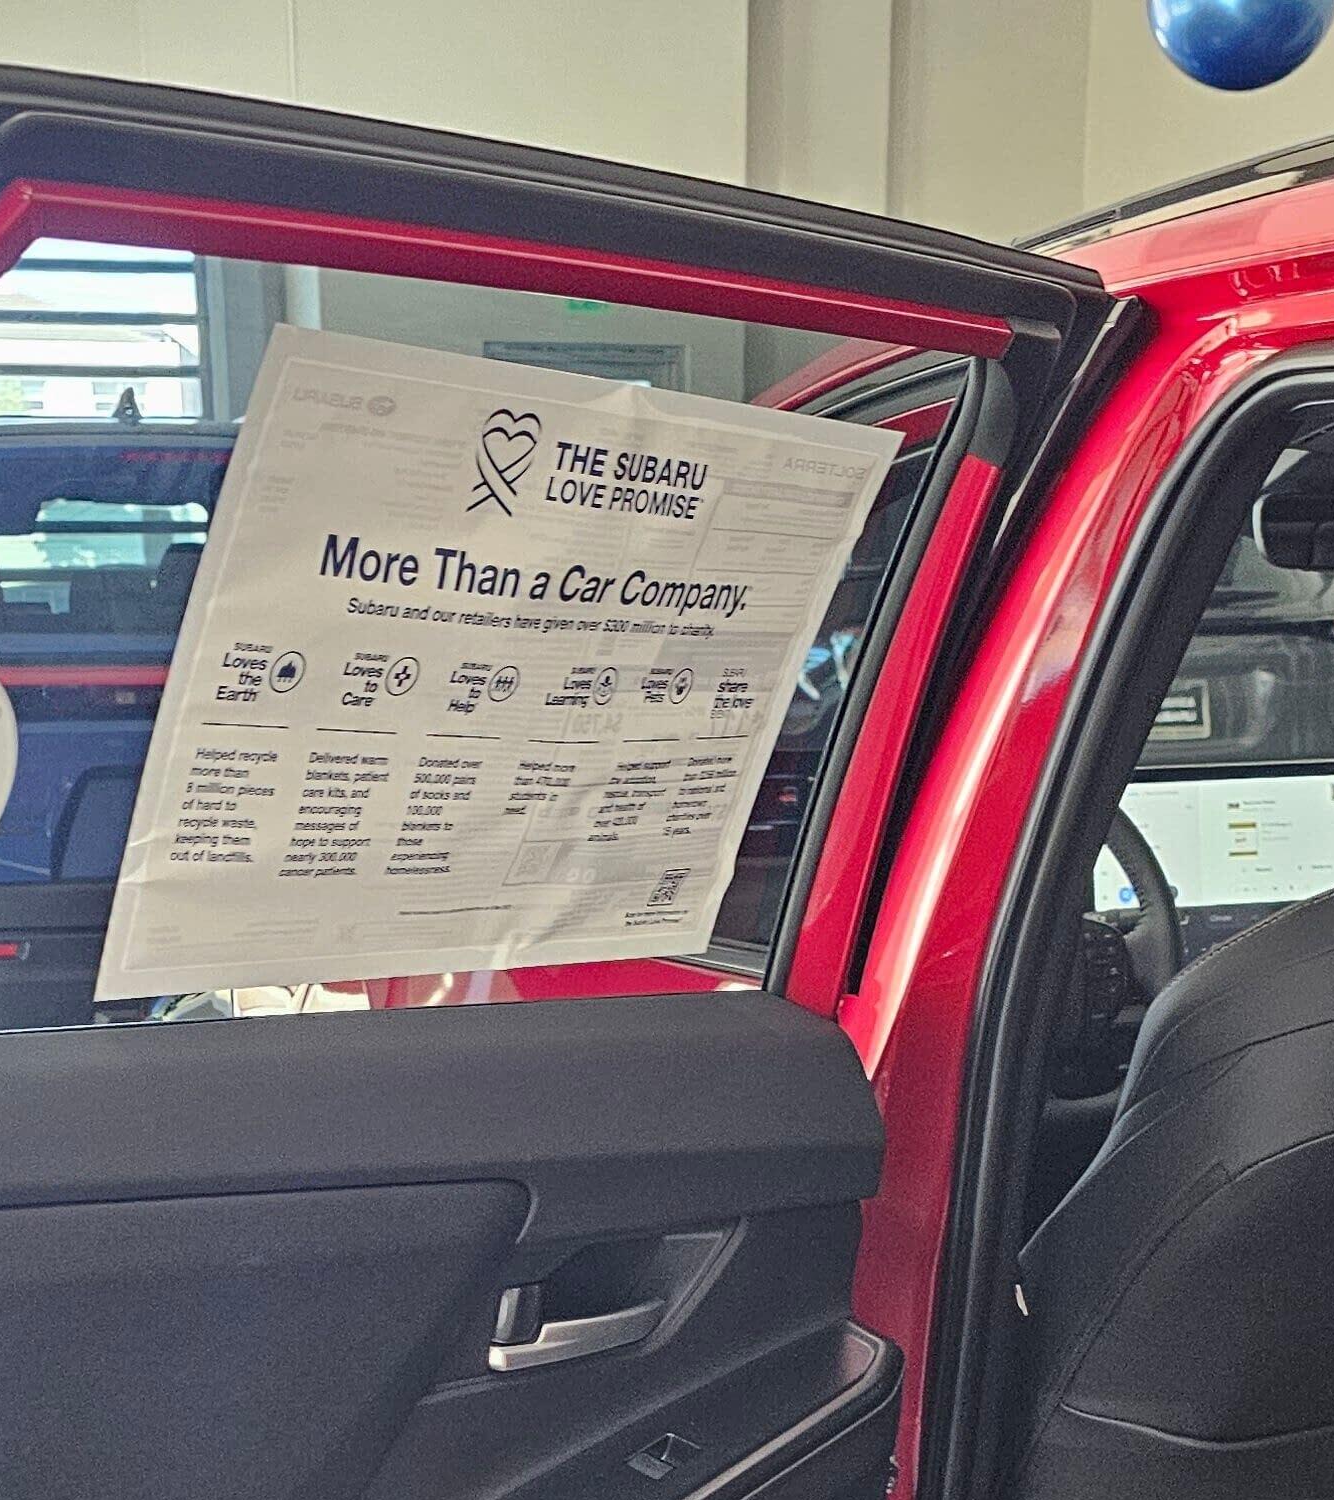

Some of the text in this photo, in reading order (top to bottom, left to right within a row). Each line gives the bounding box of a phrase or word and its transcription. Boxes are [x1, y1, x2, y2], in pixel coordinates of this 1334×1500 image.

[556, 441, 708, 491] THE SUBARU
[544, 476, 607, 508] LOVE
[609, 486, 701, 519] PROMISE
[319, 533, 749, 618] More Than a Car Company.
[346, 597, 399, 618] Subaru
[402, 605, 428, 621] and
[431, 609, 457, 623] our
[460, 612, 512, 629] retailers
[514, 614, 542, 630] have
[543, 617, 574, 633] given
[576, 620, 601, 632] over
[630, 620, 666, 635] million
[667, 621, 678, 635] to
[222, 652, 268, 670] Loves
[343, 662, 384, 679] Loves
[238, 671, 262, 686] the
[449, 671, 486, 687] Loves
[563, 676, 593, 690] Loves
[641, 676, 669, 690] Loves
[363, 679, 378, 693] to
[468, 686, 482, 699] to
[717, 680, 748, 693] share
[215, 685, 259, 703] Earth
[341, 691, 374, 708] Care
[545, 692, 589, 708] Learning
[446, 699, 476, 715] Help
[732, 696, 755, 709] love
[195, 747, 278, 764] Helped recycle
[308, 751, 359, 764] Delivered
[418, 756, 460, 768] Donated
[189, 767, 249, 779] more than
[352, 772, 389, 784] patient
[195, 782, 235, 794] million
[236, 785, 275, 797] pieces
[302, 788, 325, 798] care
[350, 788, 371, 799] and
[410, 788, 473, 800] of socks and
[181, 799, 238, 811] of hard to
[298, 804, 363, 817] encouraging
[178, 817, 218, 830] recycle
[294, 820, 361, 834] messages of
[174, 833, 252, 847] keeping them
[289, 836, 371, 849] hope to support
[170, 850, 254, 863] out of landfills.
[284, 852, 316, 864] nearly
[278, 867, 314, 877] cancer
